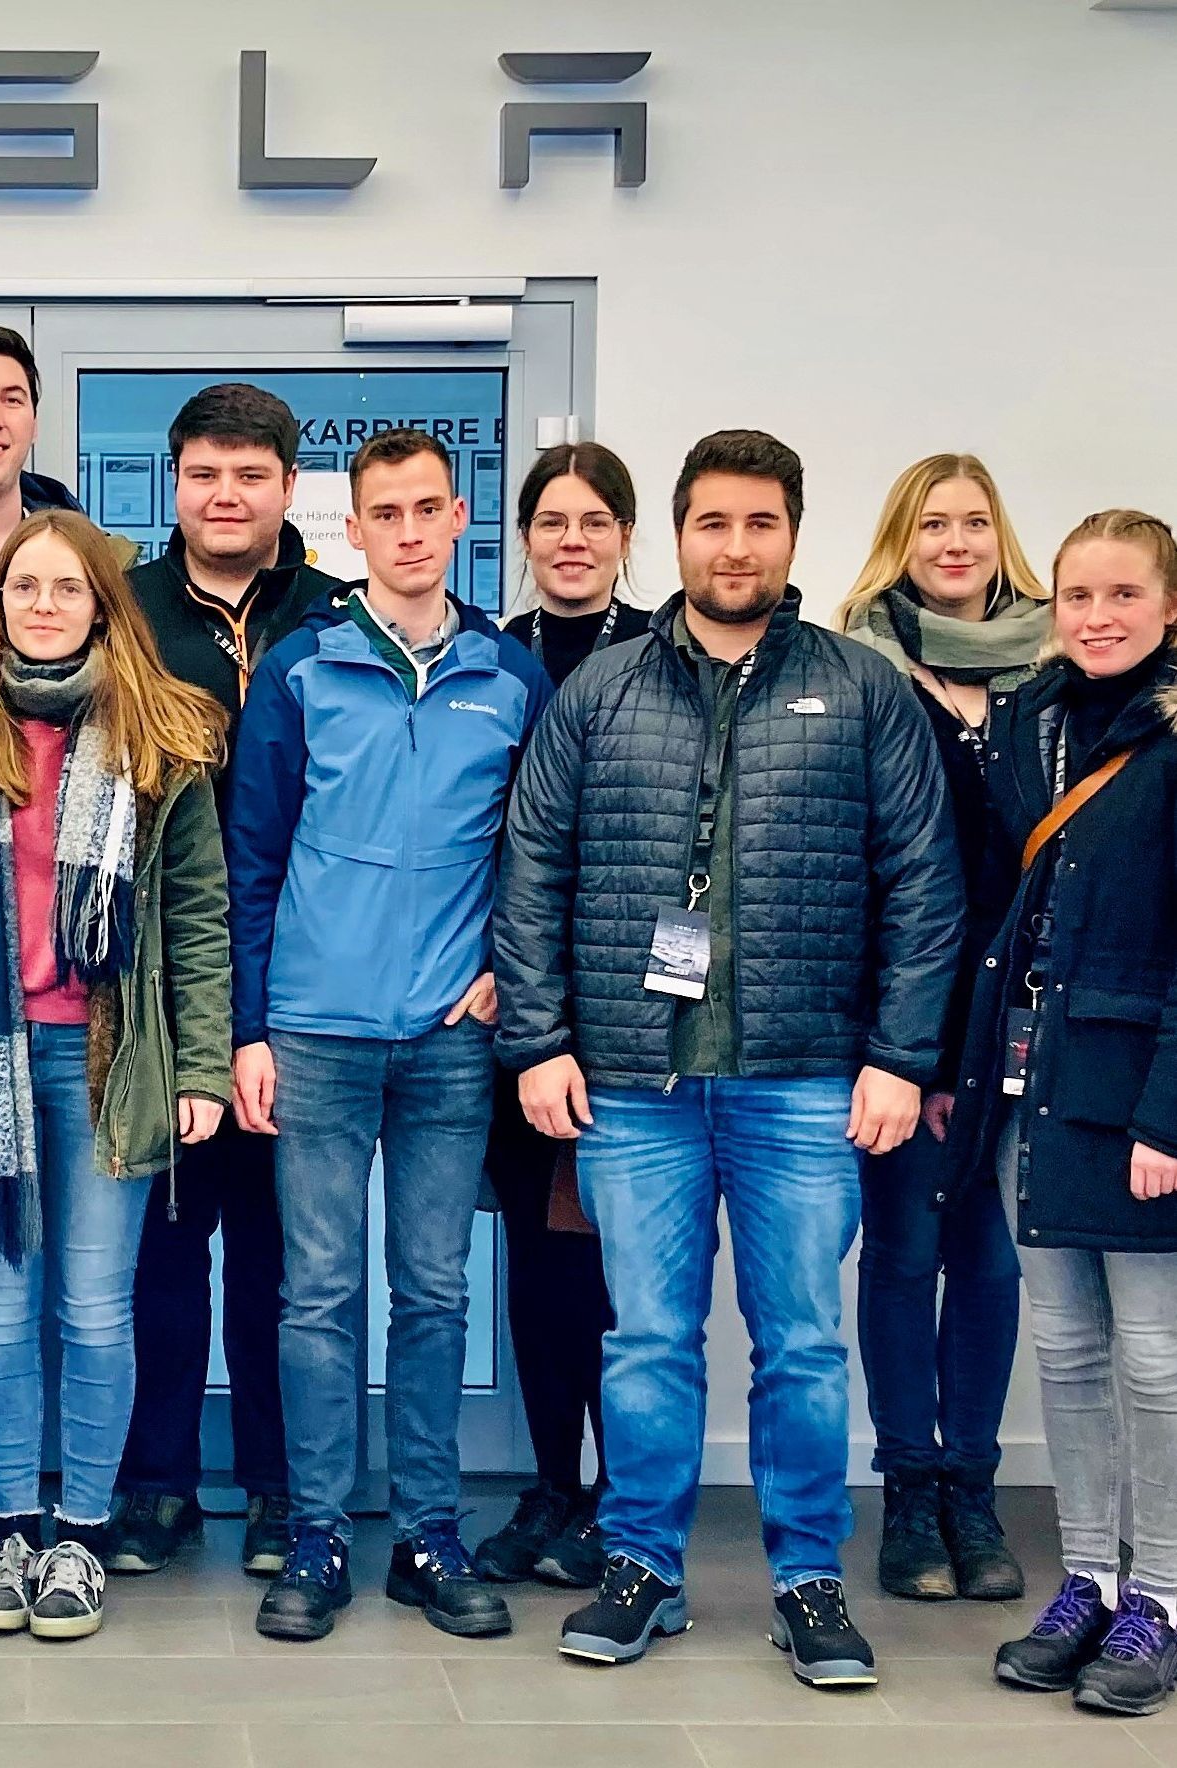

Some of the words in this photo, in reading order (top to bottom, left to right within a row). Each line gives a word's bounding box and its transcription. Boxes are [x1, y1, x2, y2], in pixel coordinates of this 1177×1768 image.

[302, 529, 344, 541] fizieren
[601, 602, 619, 635] TESL
[214, 629, 245, 666] TESL
